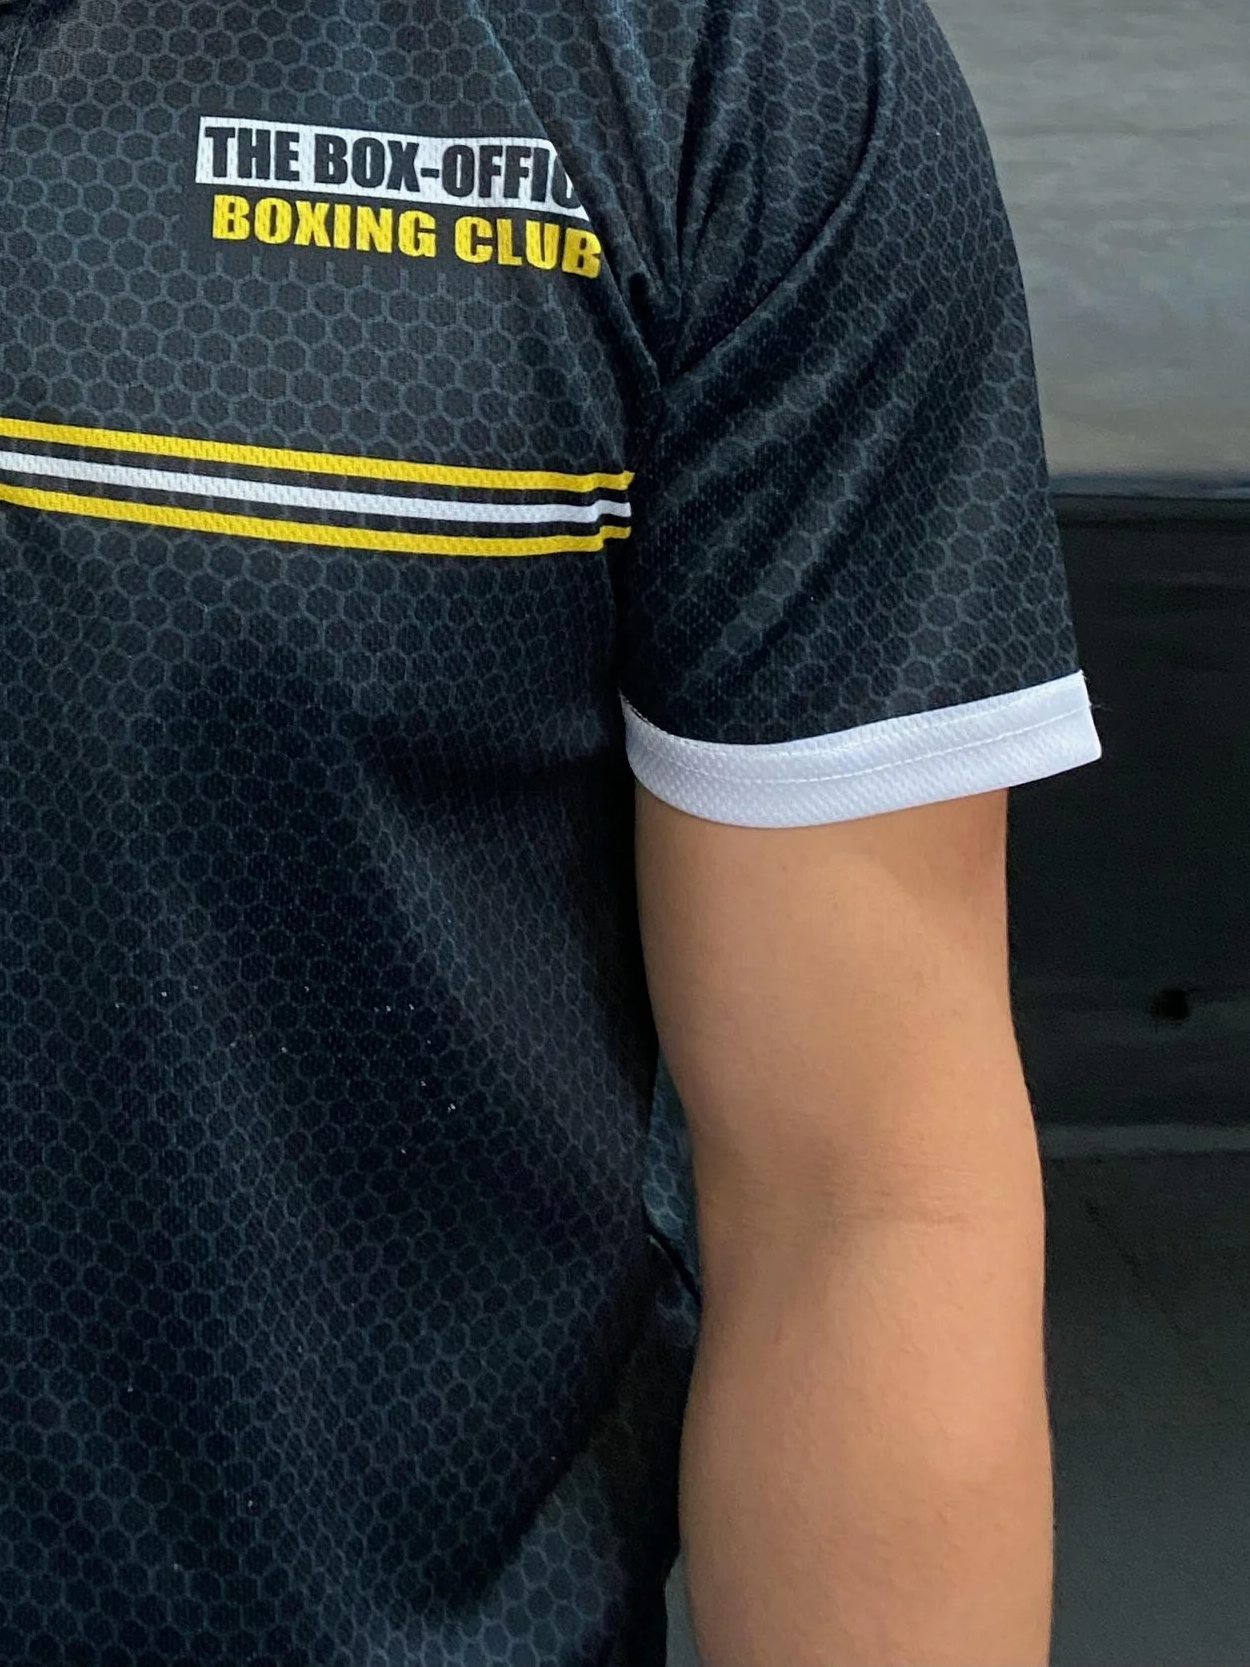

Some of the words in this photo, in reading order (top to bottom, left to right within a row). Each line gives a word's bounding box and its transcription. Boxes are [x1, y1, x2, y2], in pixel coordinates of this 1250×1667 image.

[204, 126, 301, 182] THE
[212, 193, 438, 258] BOXING
[454, 215, 602, 279] CLUB
